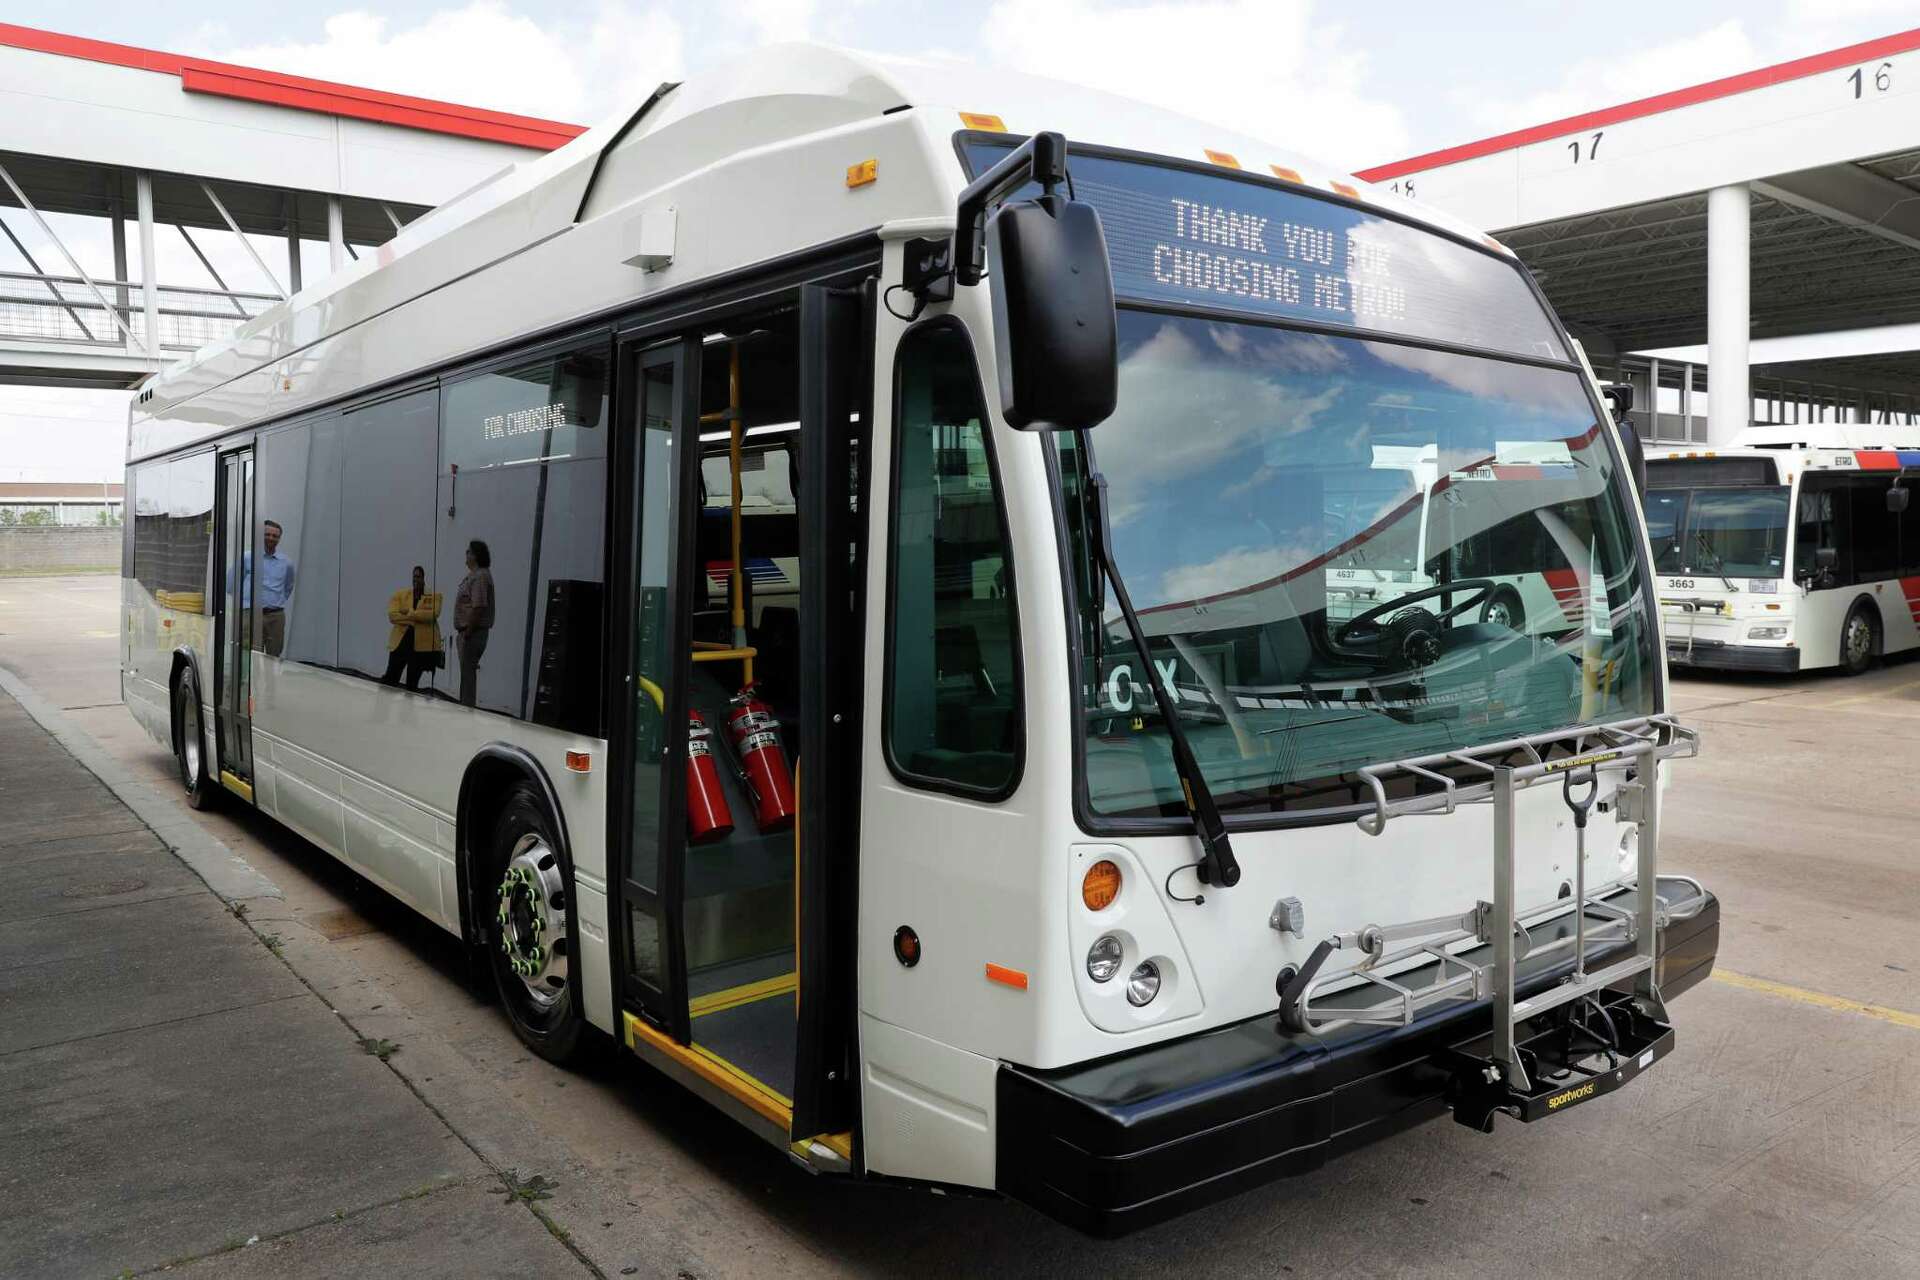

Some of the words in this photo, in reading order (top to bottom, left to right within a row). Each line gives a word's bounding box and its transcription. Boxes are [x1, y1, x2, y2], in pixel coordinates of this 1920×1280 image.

[1847, 62, 1892, 99] 16
[1568, 131, 1603, 164] 17
[1390, 180, 1416, 199] 18
[1171, 198, 1267, 253] THANK
[1283, 222, 1333, 265] YOU
[1154, 243, 1299, 303] CHOOSING
[484, 415, 504, 440] FOR
[507, 403, 566, 435] CHOOSING
[1668, 579, 1695, 589] 3663
[1548, 1083, 1595, 1109] sportworks
